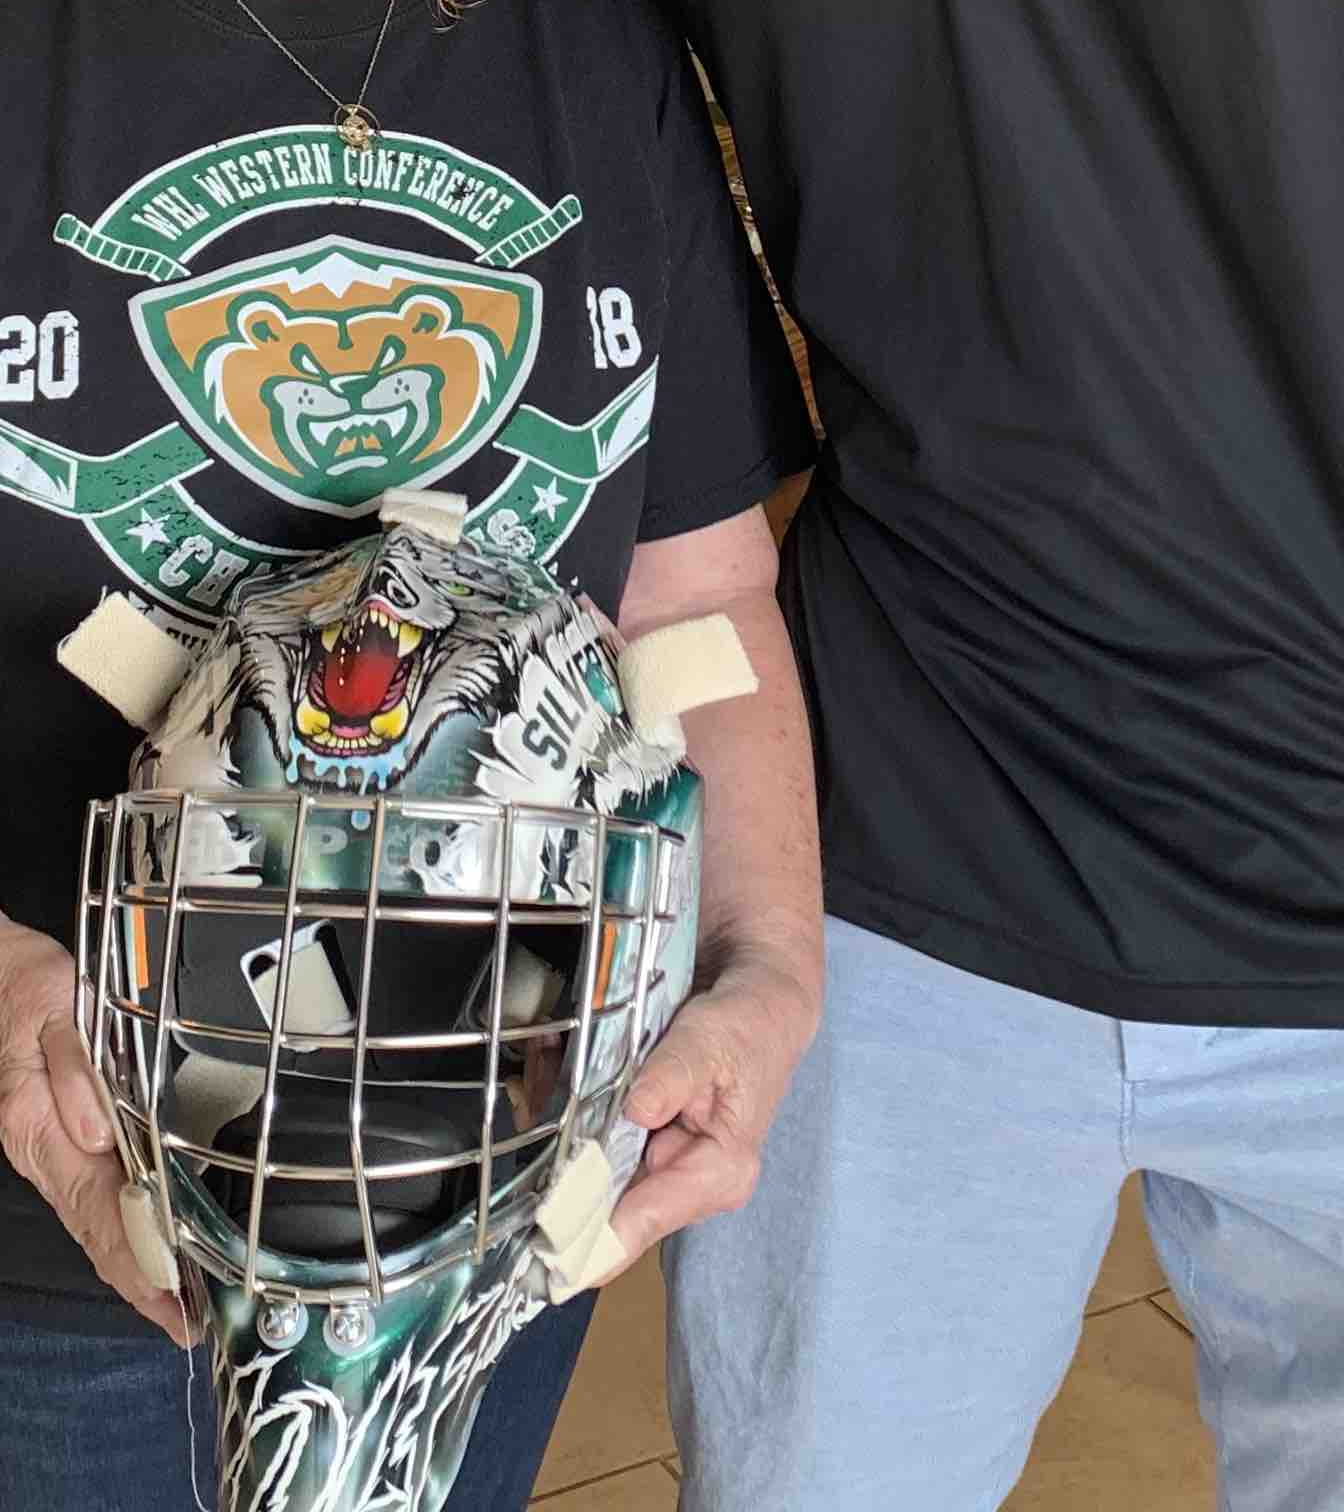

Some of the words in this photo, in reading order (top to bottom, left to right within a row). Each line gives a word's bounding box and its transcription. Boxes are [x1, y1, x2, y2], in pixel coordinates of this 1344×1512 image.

[131, 185, 211, 242] WHL
[193, 143, 334, 209] WESTERN
[343, 146, 515, 231] CONFERENCE
[586, 286, 642, 369] 18
